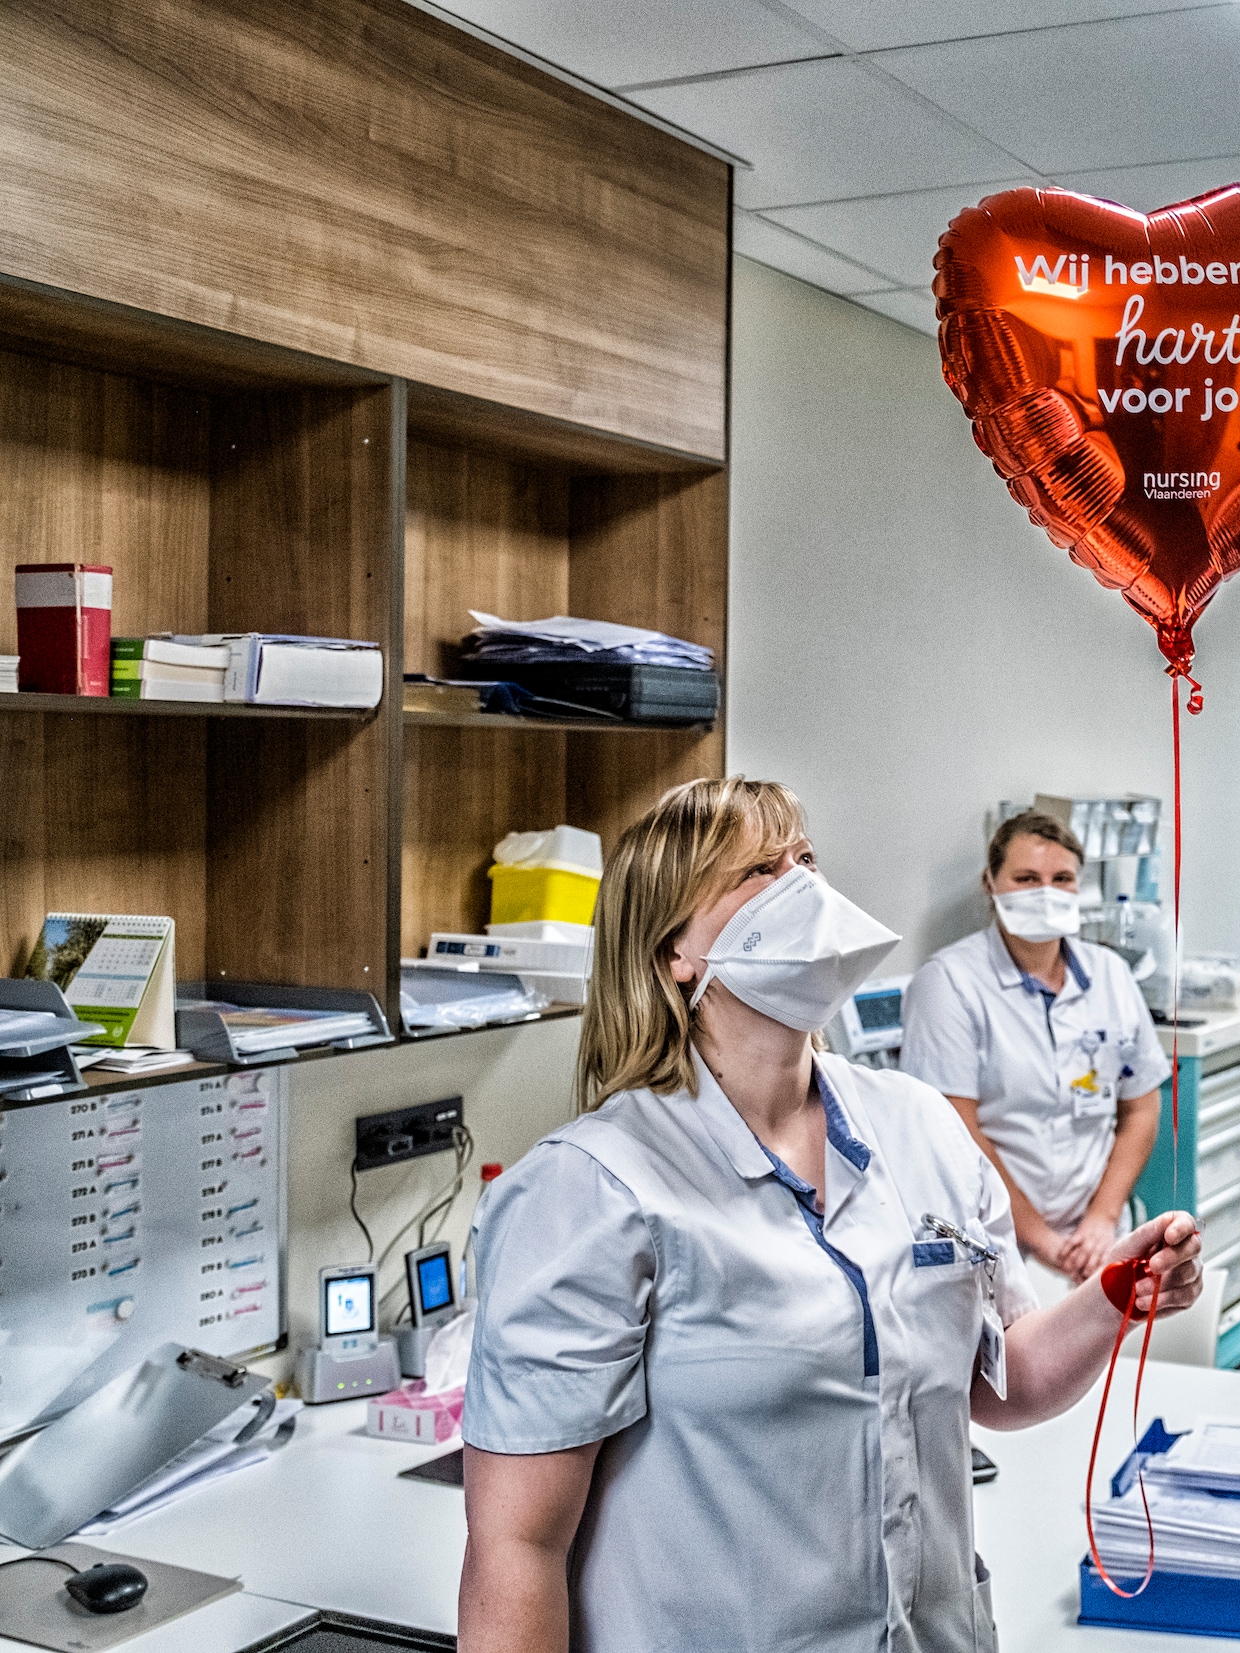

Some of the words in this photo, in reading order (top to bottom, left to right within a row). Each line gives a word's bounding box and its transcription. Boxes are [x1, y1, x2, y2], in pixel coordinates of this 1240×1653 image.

[1014, 253, 1090, 293] Wij
[1098, 387, 1191, 413] voor
[1143, 471, 1221, 491] nursing
[1143, 488, 1211, 499] Vlaanderen
[71, 1131, 86, 1141] 271
[71, 1160, 86, 1171] 271
